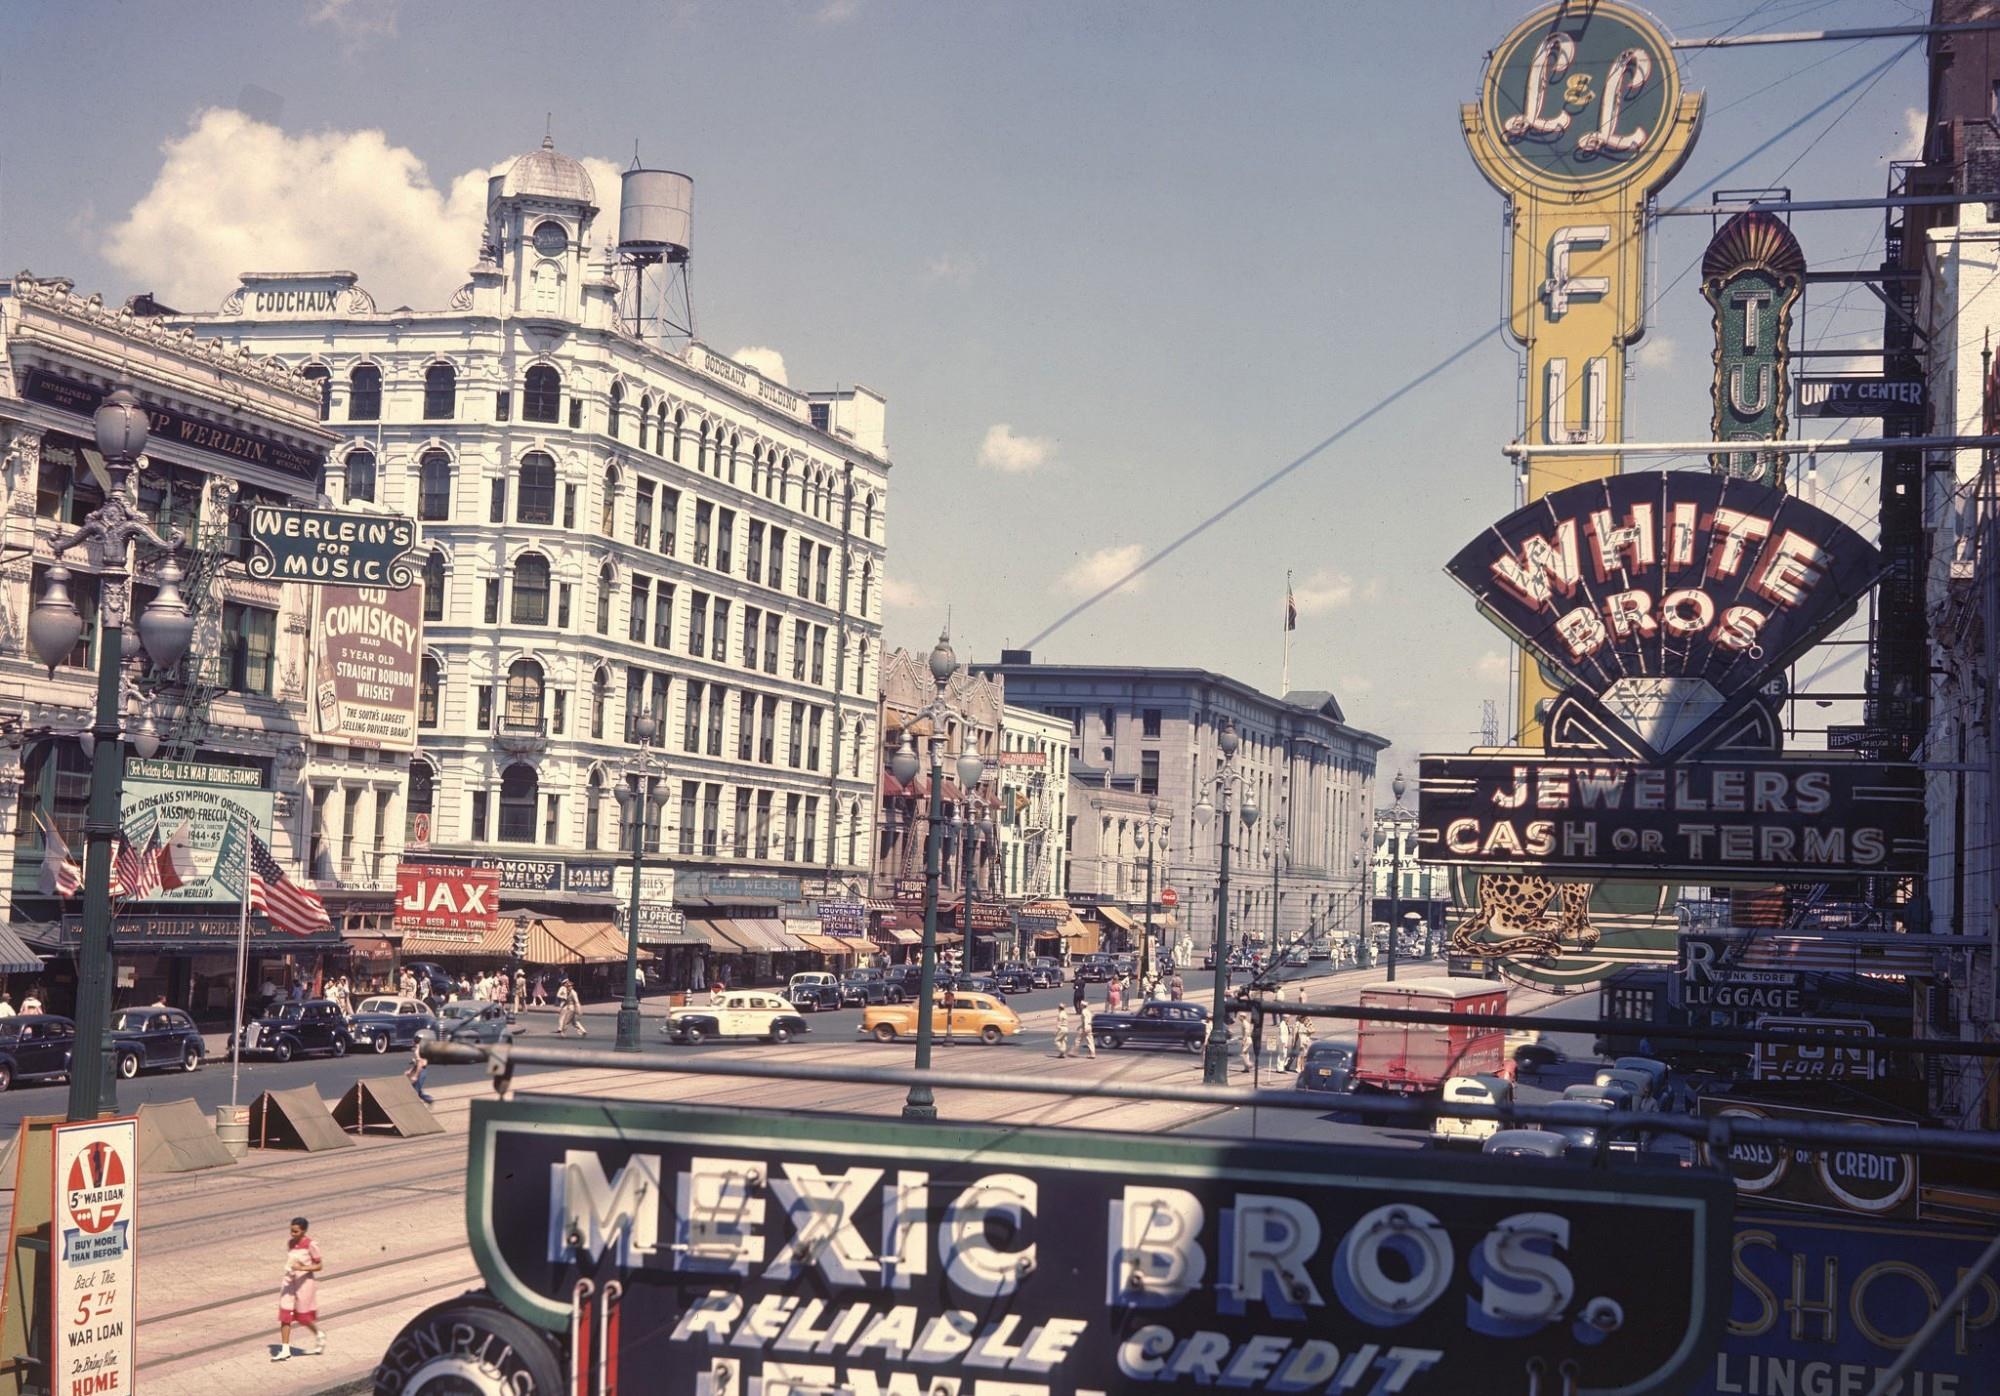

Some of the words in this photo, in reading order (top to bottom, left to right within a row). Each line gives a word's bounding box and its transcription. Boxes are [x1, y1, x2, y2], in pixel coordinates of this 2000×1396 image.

[1801, 383, 1852, 406] UNITY
[1858, 382, 1921, 405] CENTER
[180, 420, 267, 460] WERLEIN
[255, 509, 409, 546] WERLEIN'S
[317, 542, 350, 556] FOR
[1490, 502, 1834, 611] WHITE
[284, 554, 380, 580] MUSIC
[325, 604, 417, 655] COMISKEY
[1556, 588, 1768, 662] BROS
[360, 636, 381, 647] BRAND
[342, 648, 348, 658] 5
[349, 649, 375, 662] YEAR
[378, 655, 395, 666] OLD
[336, 661, 377, 680] STRAIGHT
[378, 667, 414, 688] BOURBON
[356, 681, 395, 702] WHISKEY
[342, 719, 366, 732] SELLING
[366, 723, 389, 736] PRIVATE
[381, 712, 406, 725] LARGEST
[162, 763, 176, 779] Buy
[191, 766, 206, 781] WAR
[233, 770, 259, 785] STAMPS
[1493, 766, 1831, 814] JEWELERS
[121, 803, 137, 820] NEW
[138, 792, 174, 810] ORLEANS
[175, 791, 219, 806] SYMPHONY
[160, 806, 195, 820] MASSIMO
[199, 808, 228, 822] FRECCIA
[1446, 817, 1597, 857] CASH
[1612, 828, 1667, 853] OR
[1677, 825, 1887, 863] TERMS
[427, 867, 464, 877] DRINK
[482, 861, 555, 874] DIAMONDS
[567, 869, 610, 888] LOANS
[712, 880, 736, 889] LOU
[744, 880, 797, 890] WELSCH
[184, 888, 213, 898] WERLEIN'S
[403, 880, 489, 915] JAX
[649, 912, 682, 924] OFFICE
[820, 907, 861, 916] SOUVENIRS
[147, 921, 194, 936] PHILIP
[199, 922, 257, 936] WERLEN
[402, 916, 421, 925] BEST
[426, 917, 445, 926] BEER
[450, 919, 459, 927] IN
[466, 920, 487, 929] TOWN
[1752, 973, 1786, 982] STORE
[1685, 985, 1800, 1008] LUGGAGE
[1782, 1060, 1825, 1074] FOR
[1830, 1062, 1846, 1075] A
[1835, 1151, 1897, 1183] CREDIT
[84, 1190, 103, 1207] WAR
[104, 1188, 124, 1201] LOAN
[75, 1238, 92, 1251] BUY
[94, 1235, 117, 1249] MORE
[548, 1150, 1038, 1296] MEXIC
[1106, 1186, 1625, 1344] BROS.
[71, 1250, 91, 1263] THAN
[93, 1246, 122, 1260] BEFORE
[73, 1273, 96, 1290] Back
[101, 1270, 116, 1284] The
[1727, 1229, 1999, 1355] SHOP
[68, 1330, 93, 1347] WAR
[96, 1322, 123, 1340] LOAN
[670, 1290, 1087, 1373] RELIABLE
[1117, 1324, 1444, 1396] CREDIT
[376, 1322, 536, 1396] BENRUS
[72, 1371, 119, 1396] HOME
